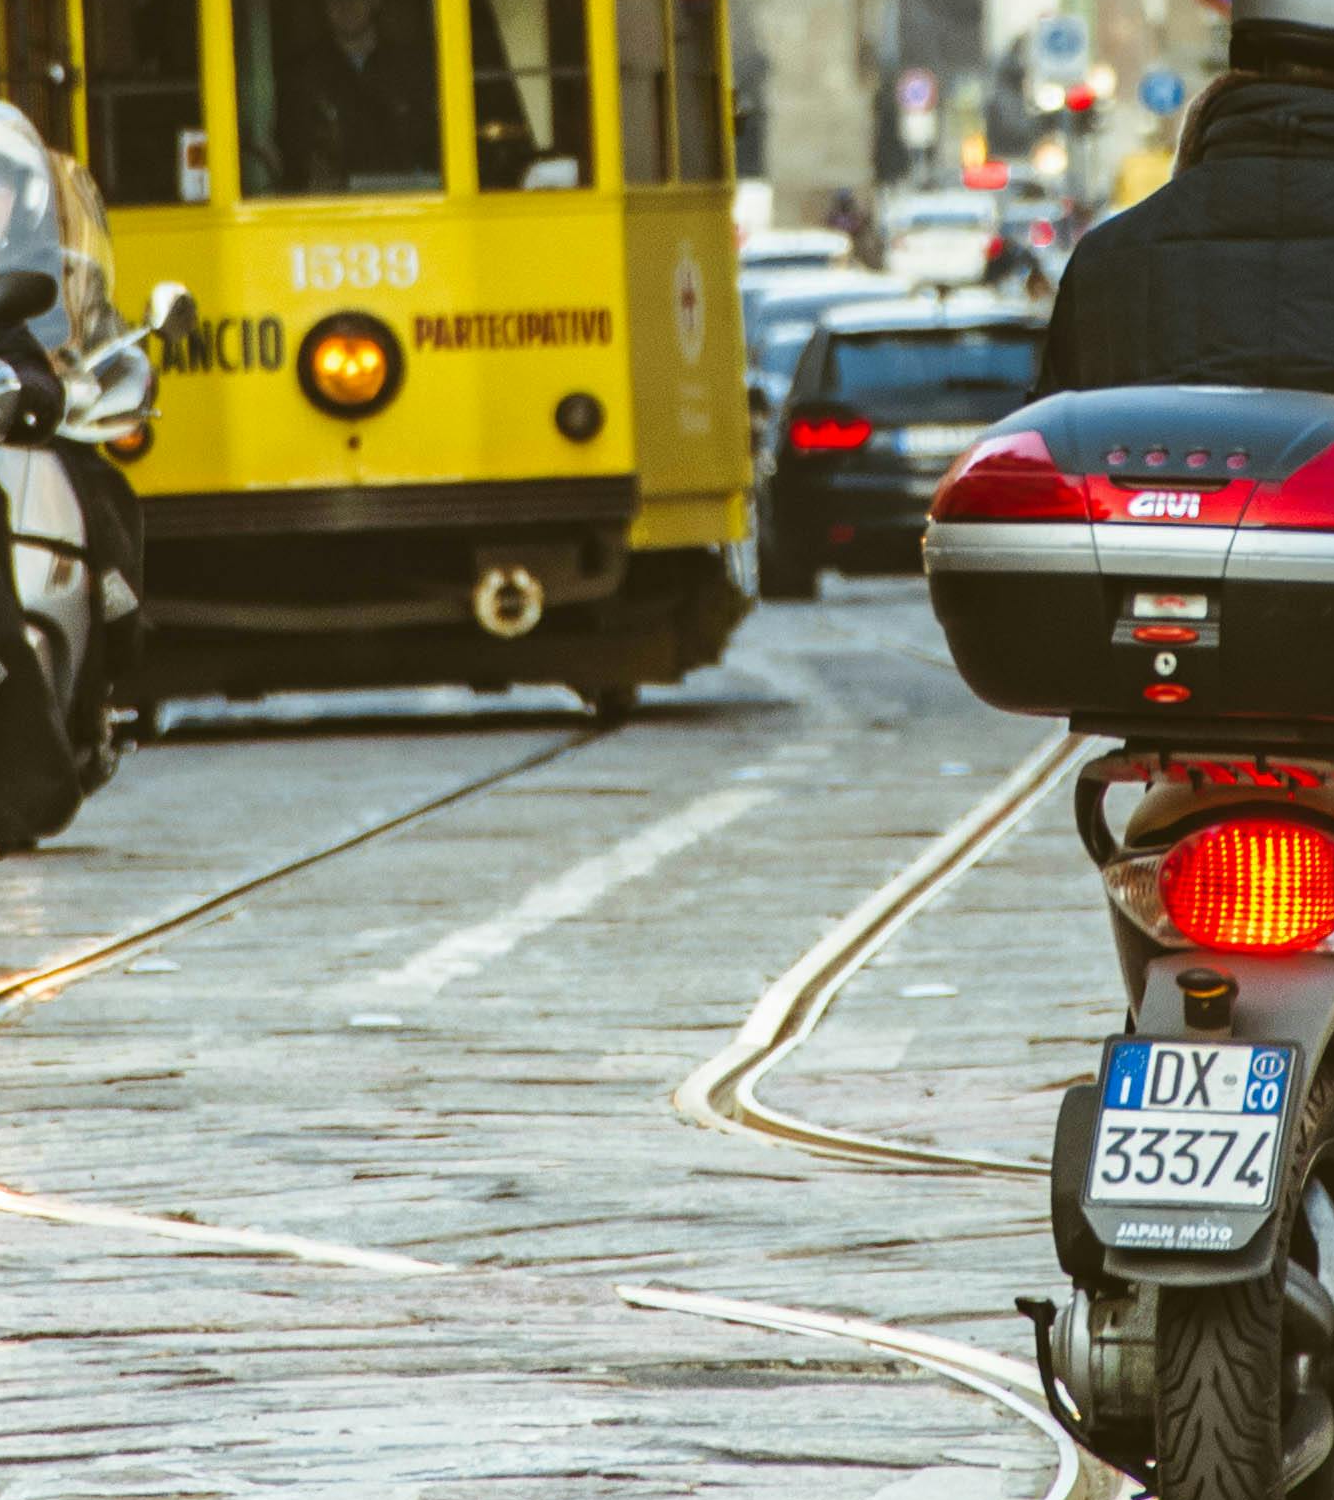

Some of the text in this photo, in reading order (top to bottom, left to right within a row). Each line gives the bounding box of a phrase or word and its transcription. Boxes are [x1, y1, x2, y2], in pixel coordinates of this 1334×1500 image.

[414, 308, 612, 350] PARTECIPATIVO
[1128, 491, 1201, 518] GIVI
[1149, 1050, 1219, 1106] DX
[1247, 1081, 1279, 1110] CO
[1101, 1126, 1271, 1188] 33374
[1116, 1223, 1233, 1241] JAPAN MOTO
